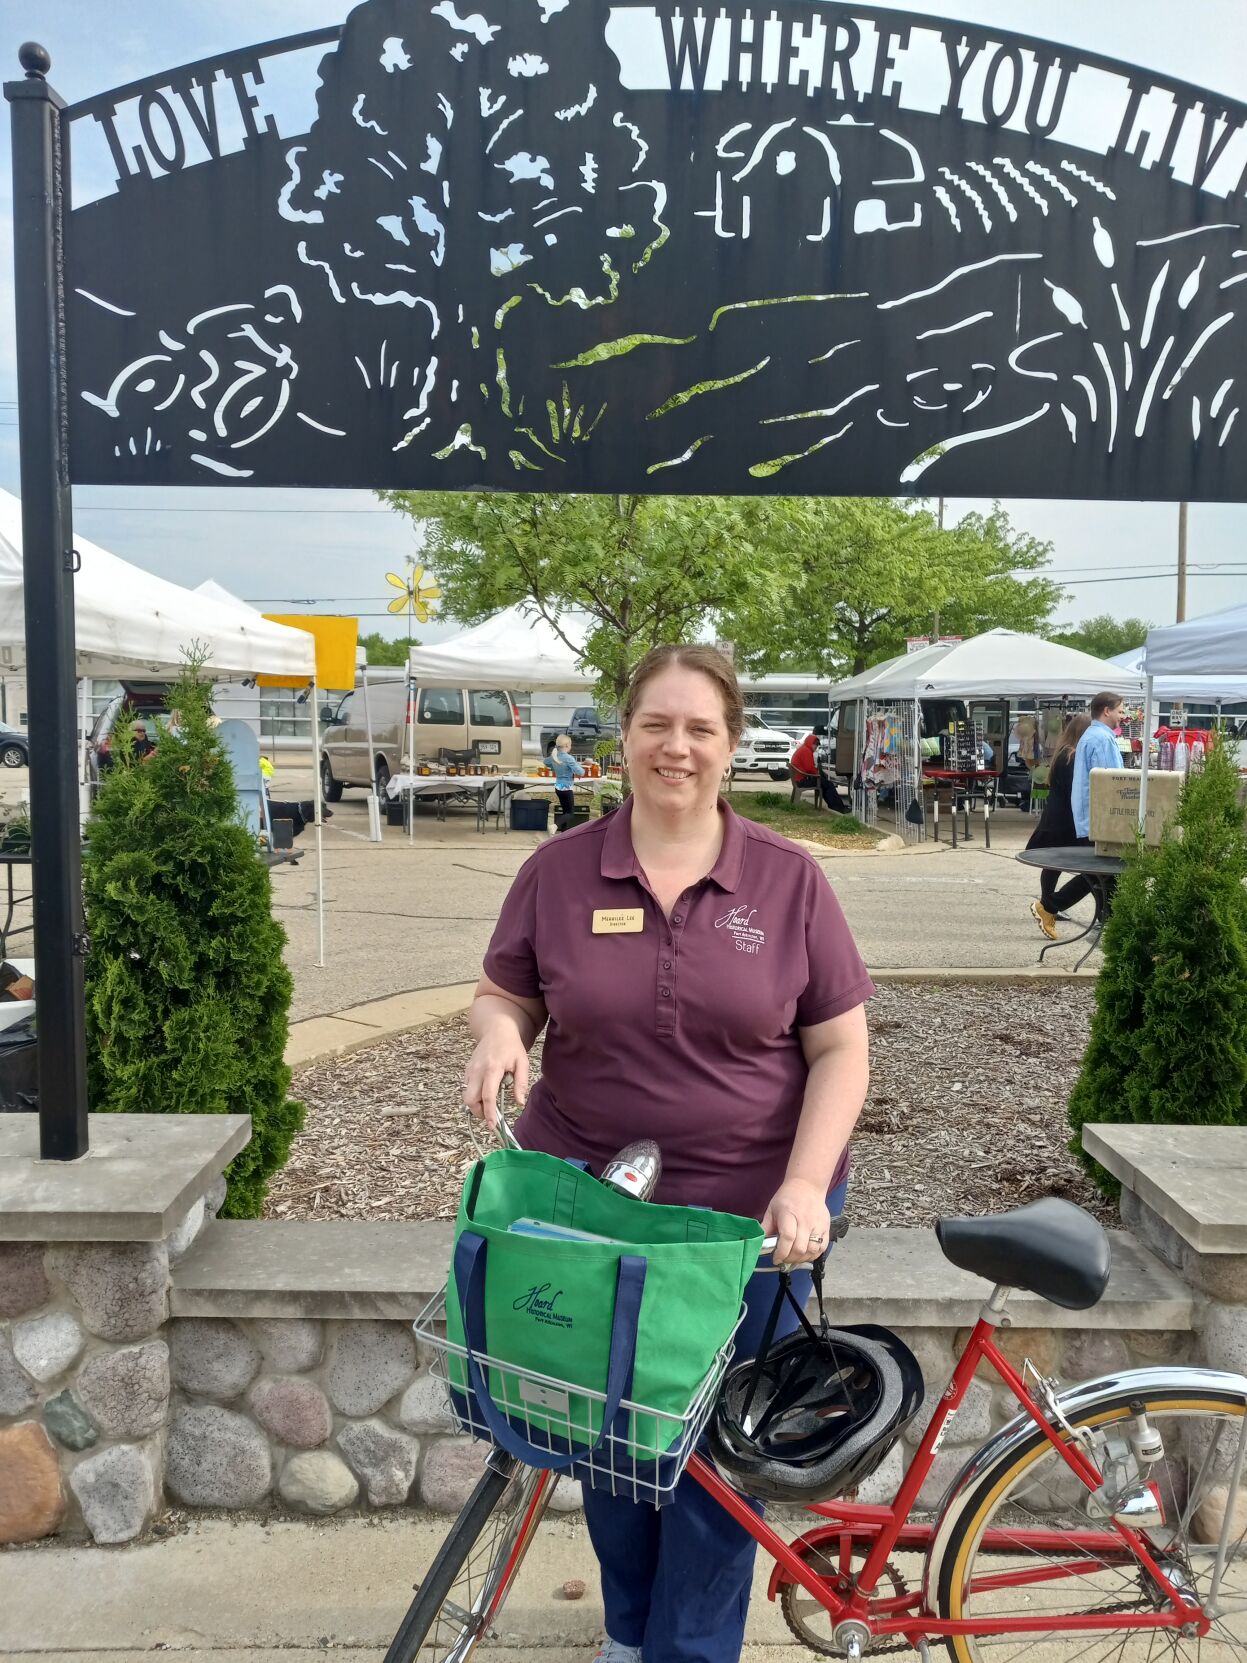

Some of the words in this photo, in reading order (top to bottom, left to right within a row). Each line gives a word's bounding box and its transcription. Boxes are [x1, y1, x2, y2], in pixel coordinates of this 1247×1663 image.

[94, 60, 280, 190] LOVE
[655, 8, 902, 107] WHERE
[941, 32, 1078, 139] YOU
[714, 904, 757, 928] Hoard
[735, 940, 760, 954] Staff
